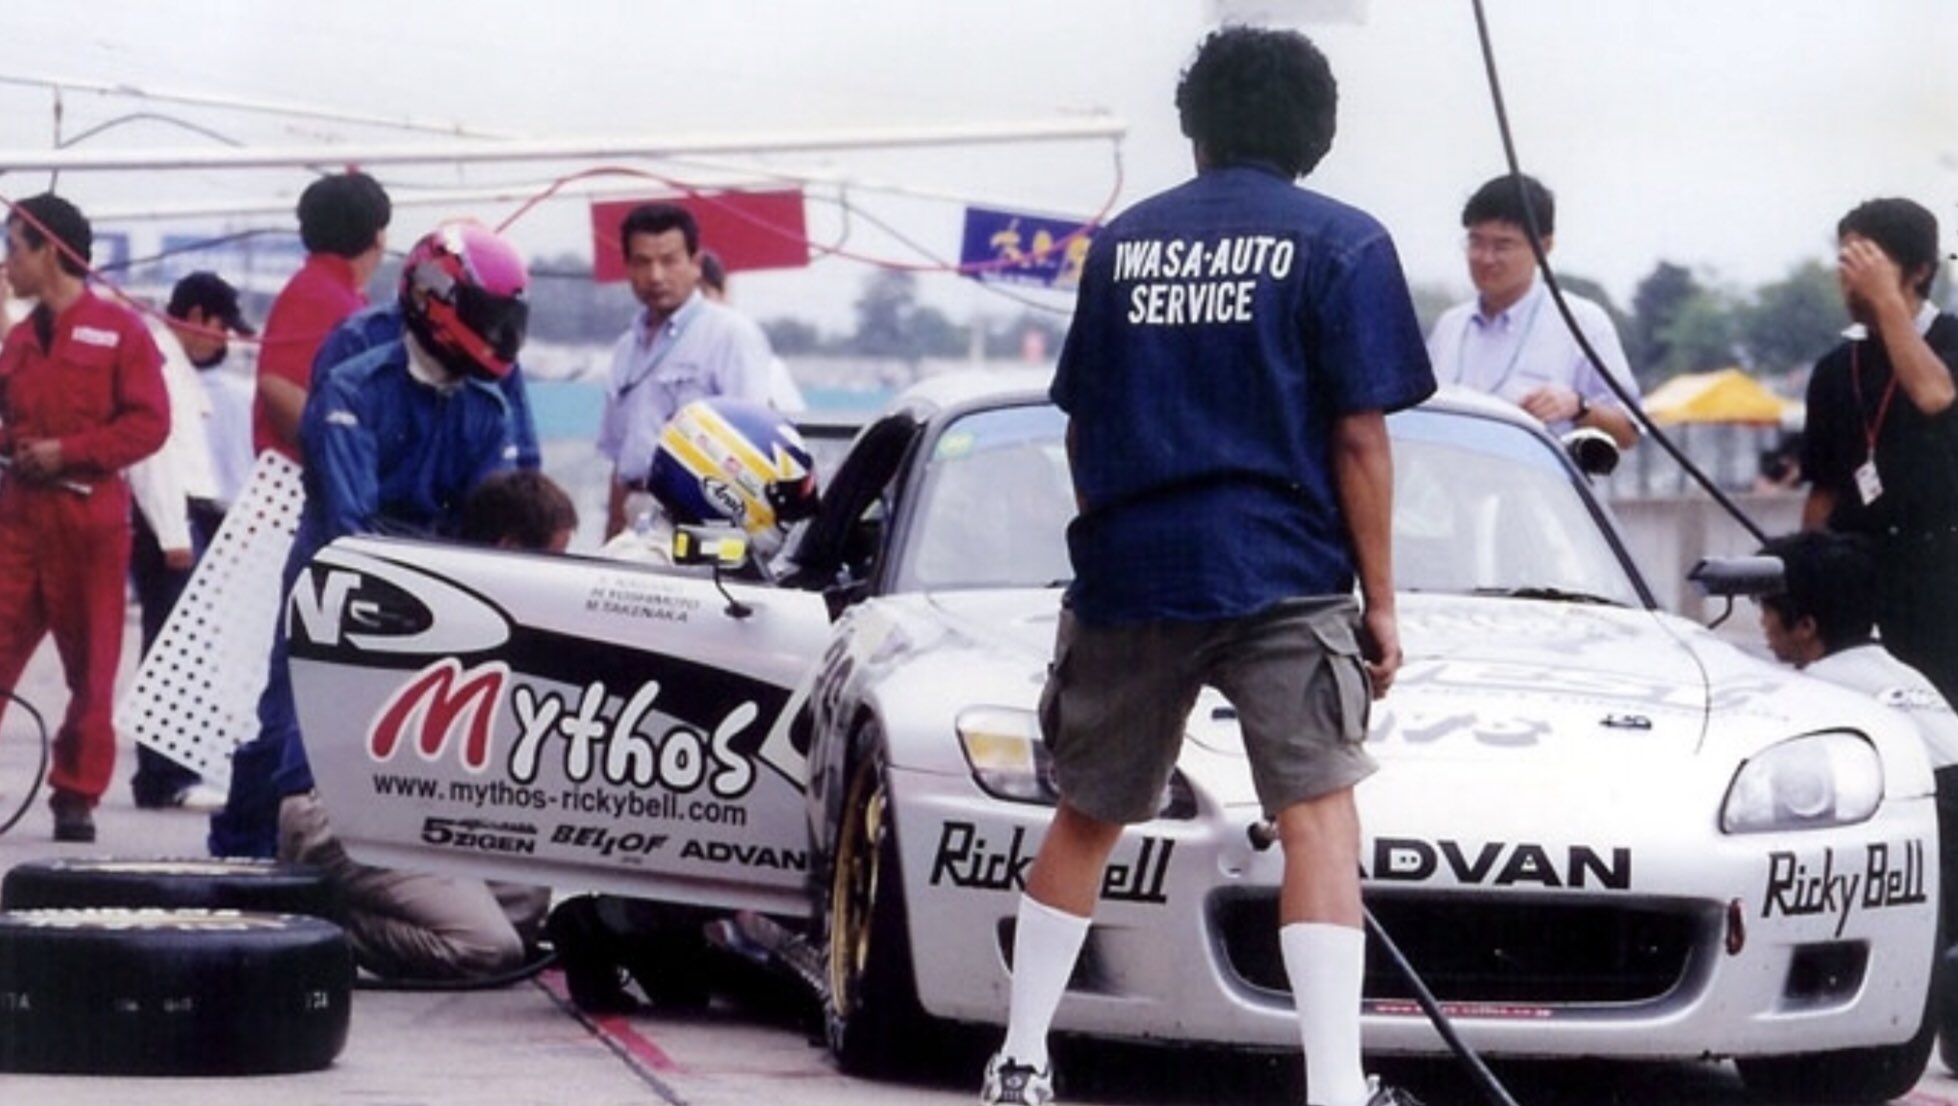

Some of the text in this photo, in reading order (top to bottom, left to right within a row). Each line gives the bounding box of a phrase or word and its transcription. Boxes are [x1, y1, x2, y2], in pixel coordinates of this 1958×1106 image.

[1128, 281, 1256, 324] SERVICE
[367, 656, 760, 800] Mythos
[373, 772, 748, 827] www.mythos-rickybell.com
[680, 839, 807, 871] ADVAN
[930, 821, 1175, 904] Rick ell
[1358, 837, 1632, 889] DVAN
[1761, 838, 1928, 938] Ricky Bell
